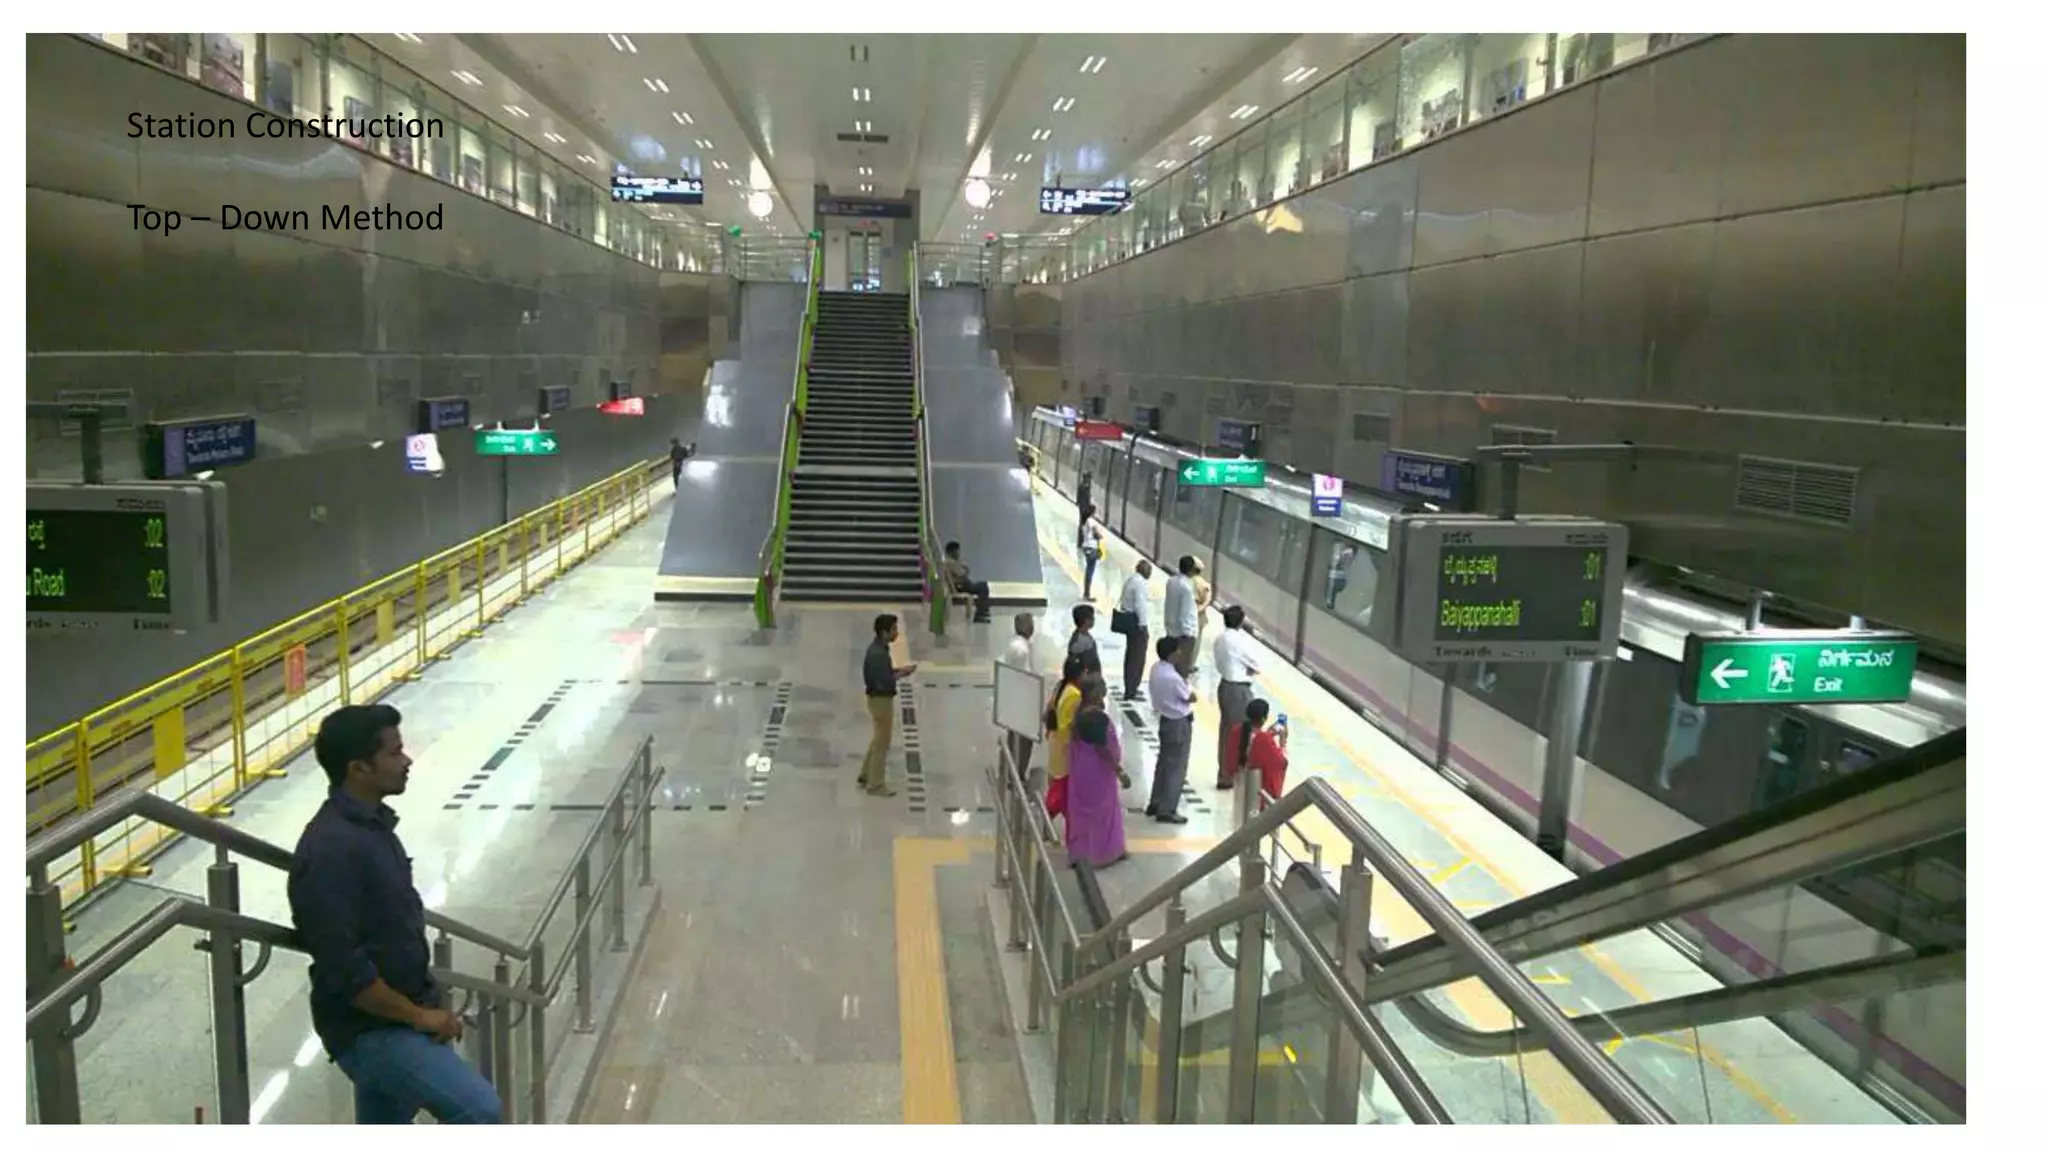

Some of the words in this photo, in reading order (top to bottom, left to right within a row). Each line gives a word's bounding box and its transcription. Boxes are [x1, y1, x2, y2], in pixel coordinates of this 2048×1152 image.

[33, 568, 65, 597] Road
[1440, 599, 1521, 633] Baiyappanahalli
[1813, 676, 1843, 693] Exit
